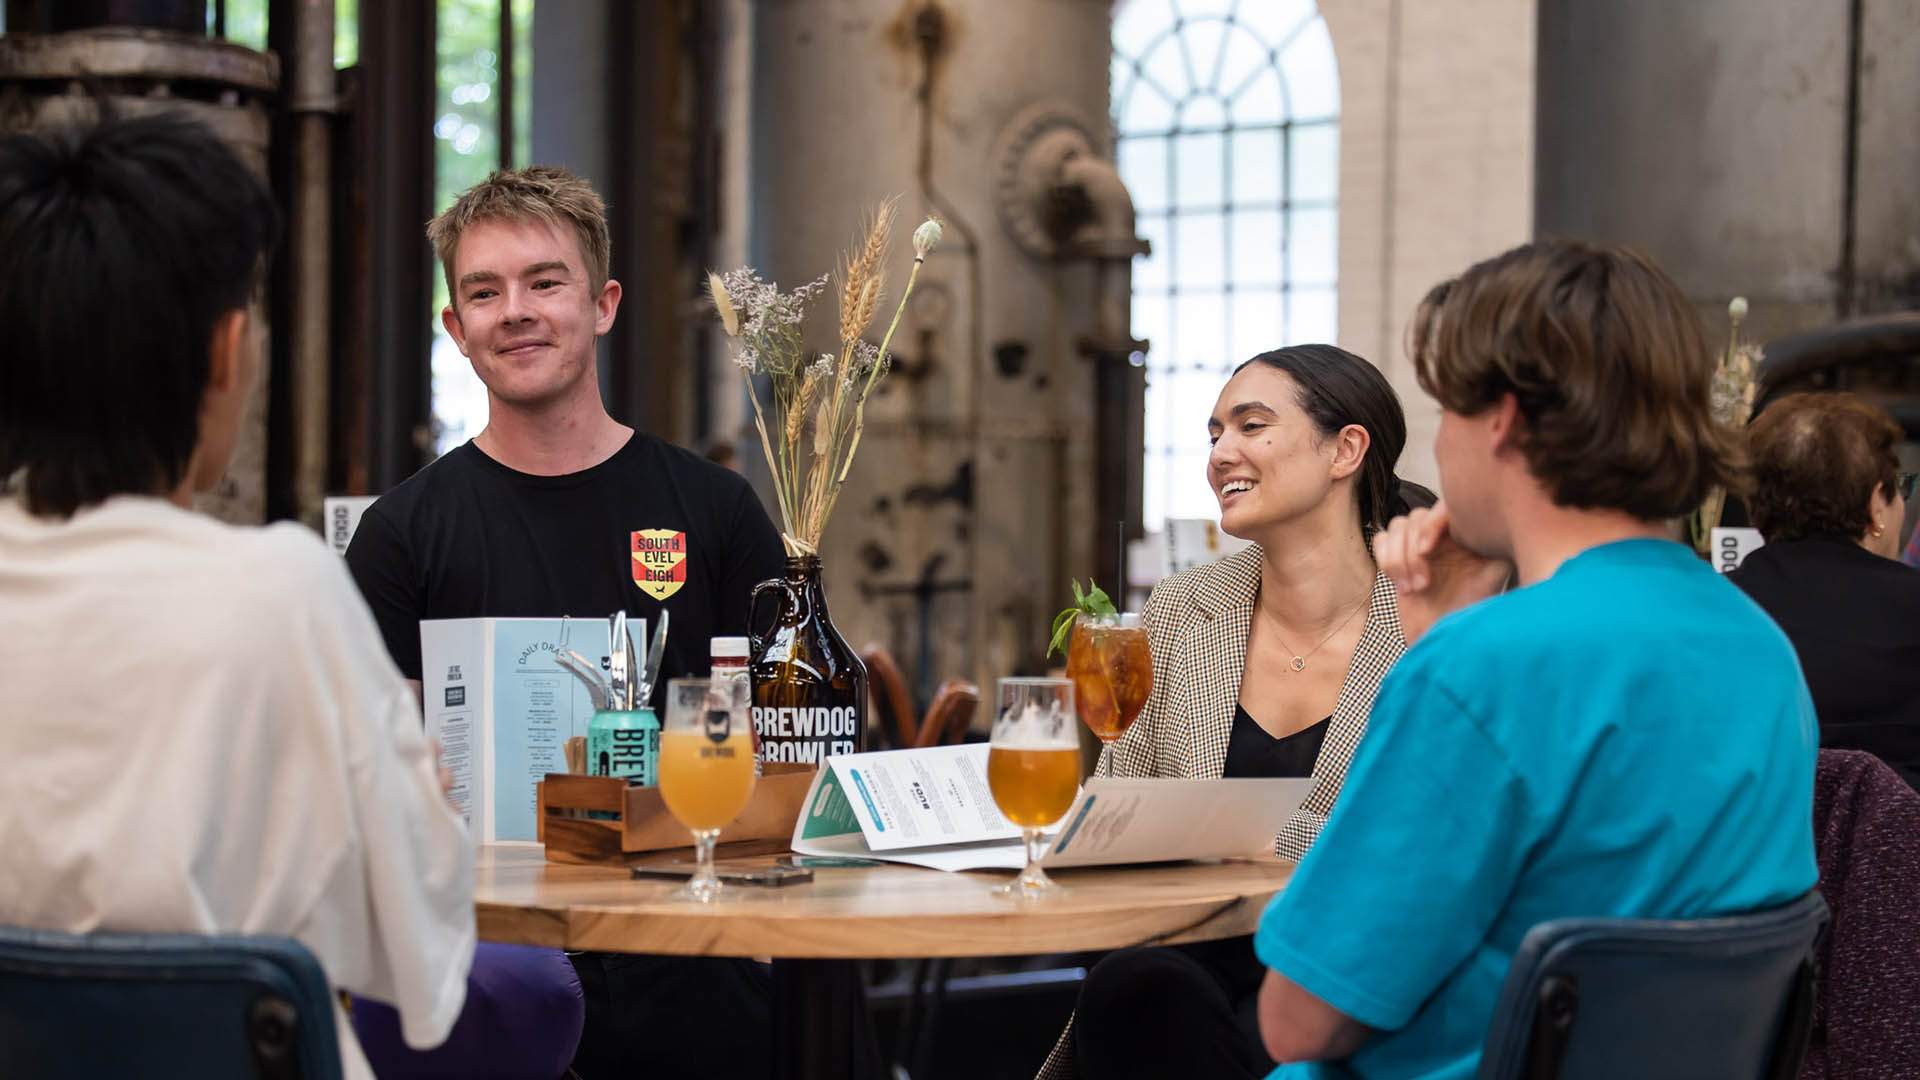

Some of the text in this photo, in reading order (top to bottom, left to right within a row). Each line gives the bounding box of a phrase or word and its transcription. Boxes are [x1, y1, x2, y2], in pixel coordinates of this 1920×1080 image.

[638, 538, 680, 550] SOUTH
[644, 551, 675, 563] EVEL
[1721, 536, 1738, 572] OOD
[645, 569, 674, 582] EIGH
[518, 641, 565, 665] DAILY DRA
[751, 706, 856, 737] BREWDOG
